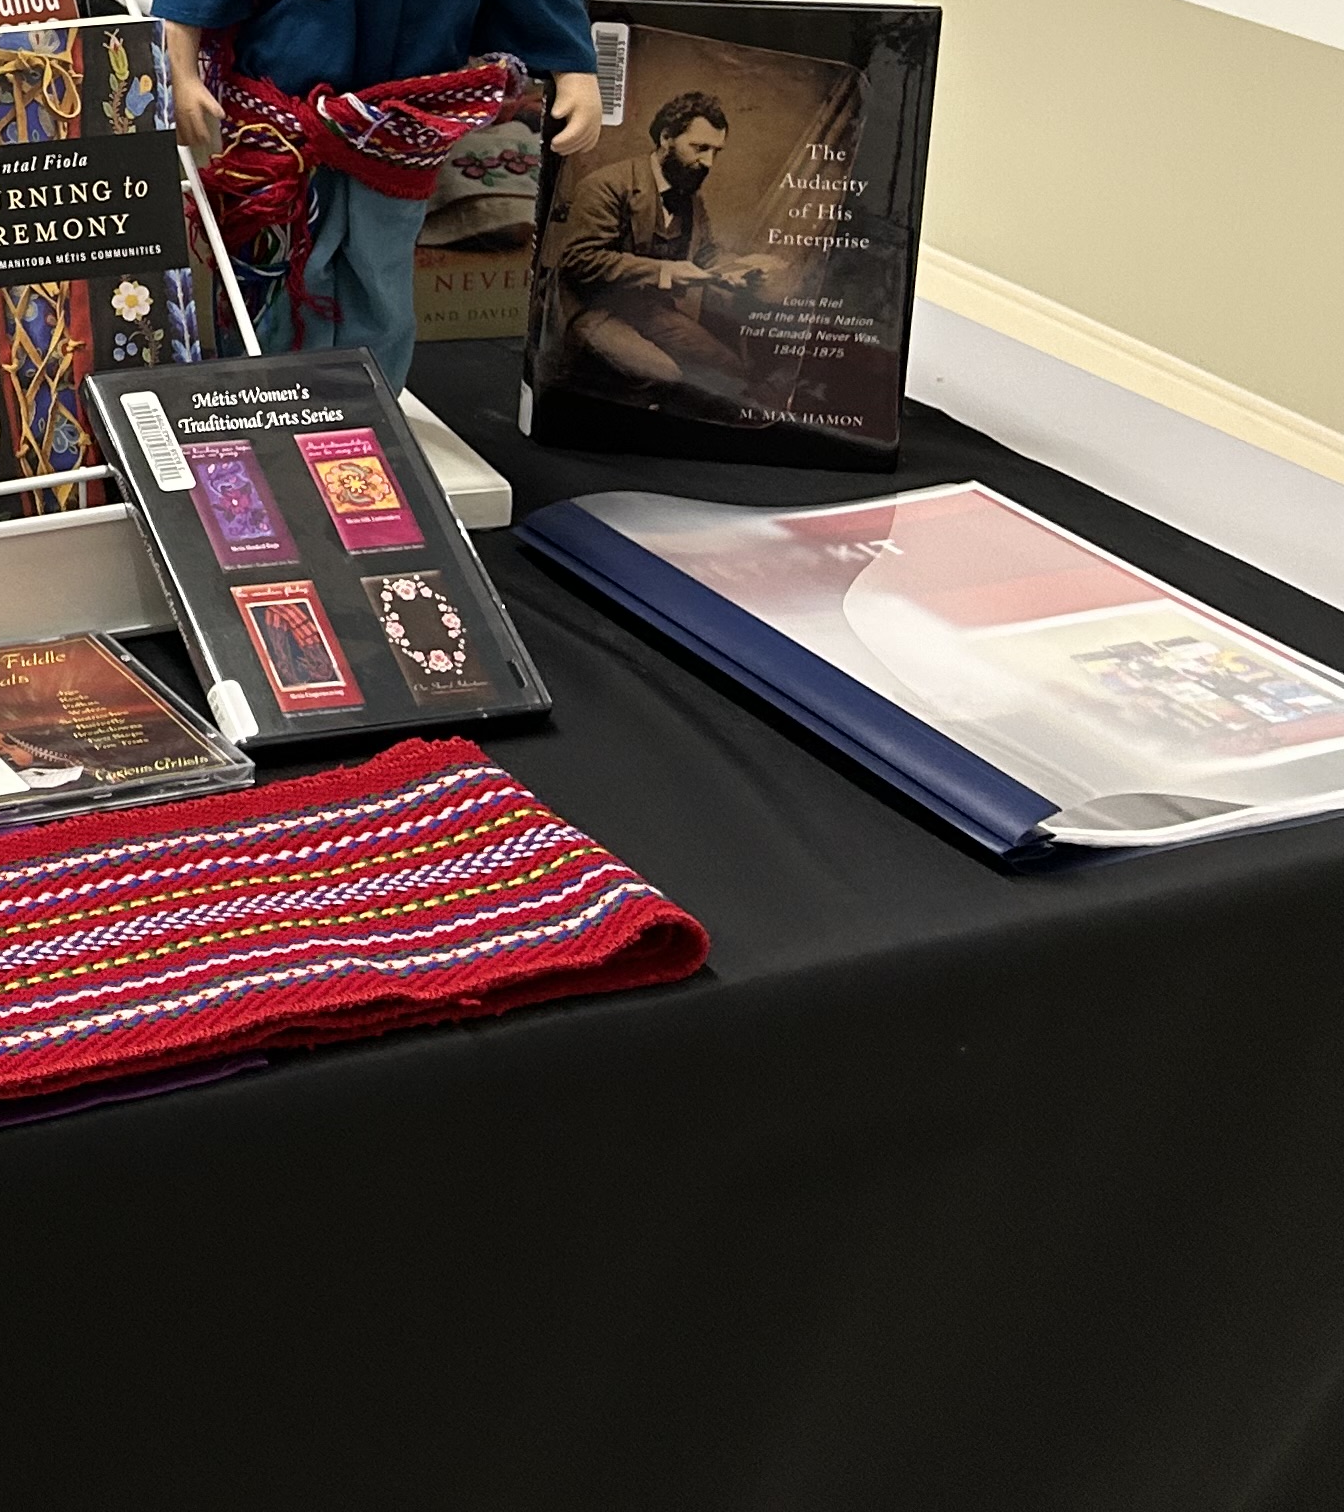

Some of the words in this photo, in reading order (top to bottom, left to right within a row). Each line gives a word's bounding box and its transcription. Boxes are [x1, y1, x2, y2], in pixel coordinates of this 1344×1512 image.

[43, 151, 89, 172] Fiola
[806, 142, 847, 161] The
[123, 175, 149, 199] to
[779, 173, 869, 197] Audacity
[788, 203, 810, 219] of
[818, 203, 853, 221] His
[768, 228, 870, 252] Enterprise
[783, 295, 815, 308] Louis
[819, 297, 844, 309] Riel
[424, 311, 459, 323] AND
[468, 306, 519, 321] DAVID
[748, 311, 771, 321] and
[774, 312, 795, 322] the
[798, 313, 831, 325] Métis
[834, 315, 874, 326] Nation
[192, 390, 237, 410] Métis
[238, 383, 310, 405] Women's
[178, 411, 264, 434] Traditional
[265, 409, 299, 429] Arts
[301, 406, 345, 424] Series
[739, 408, 758, 420] M.
[762, 409, 796, 423] MAX
[802, 412, 864, 427] HAMON
